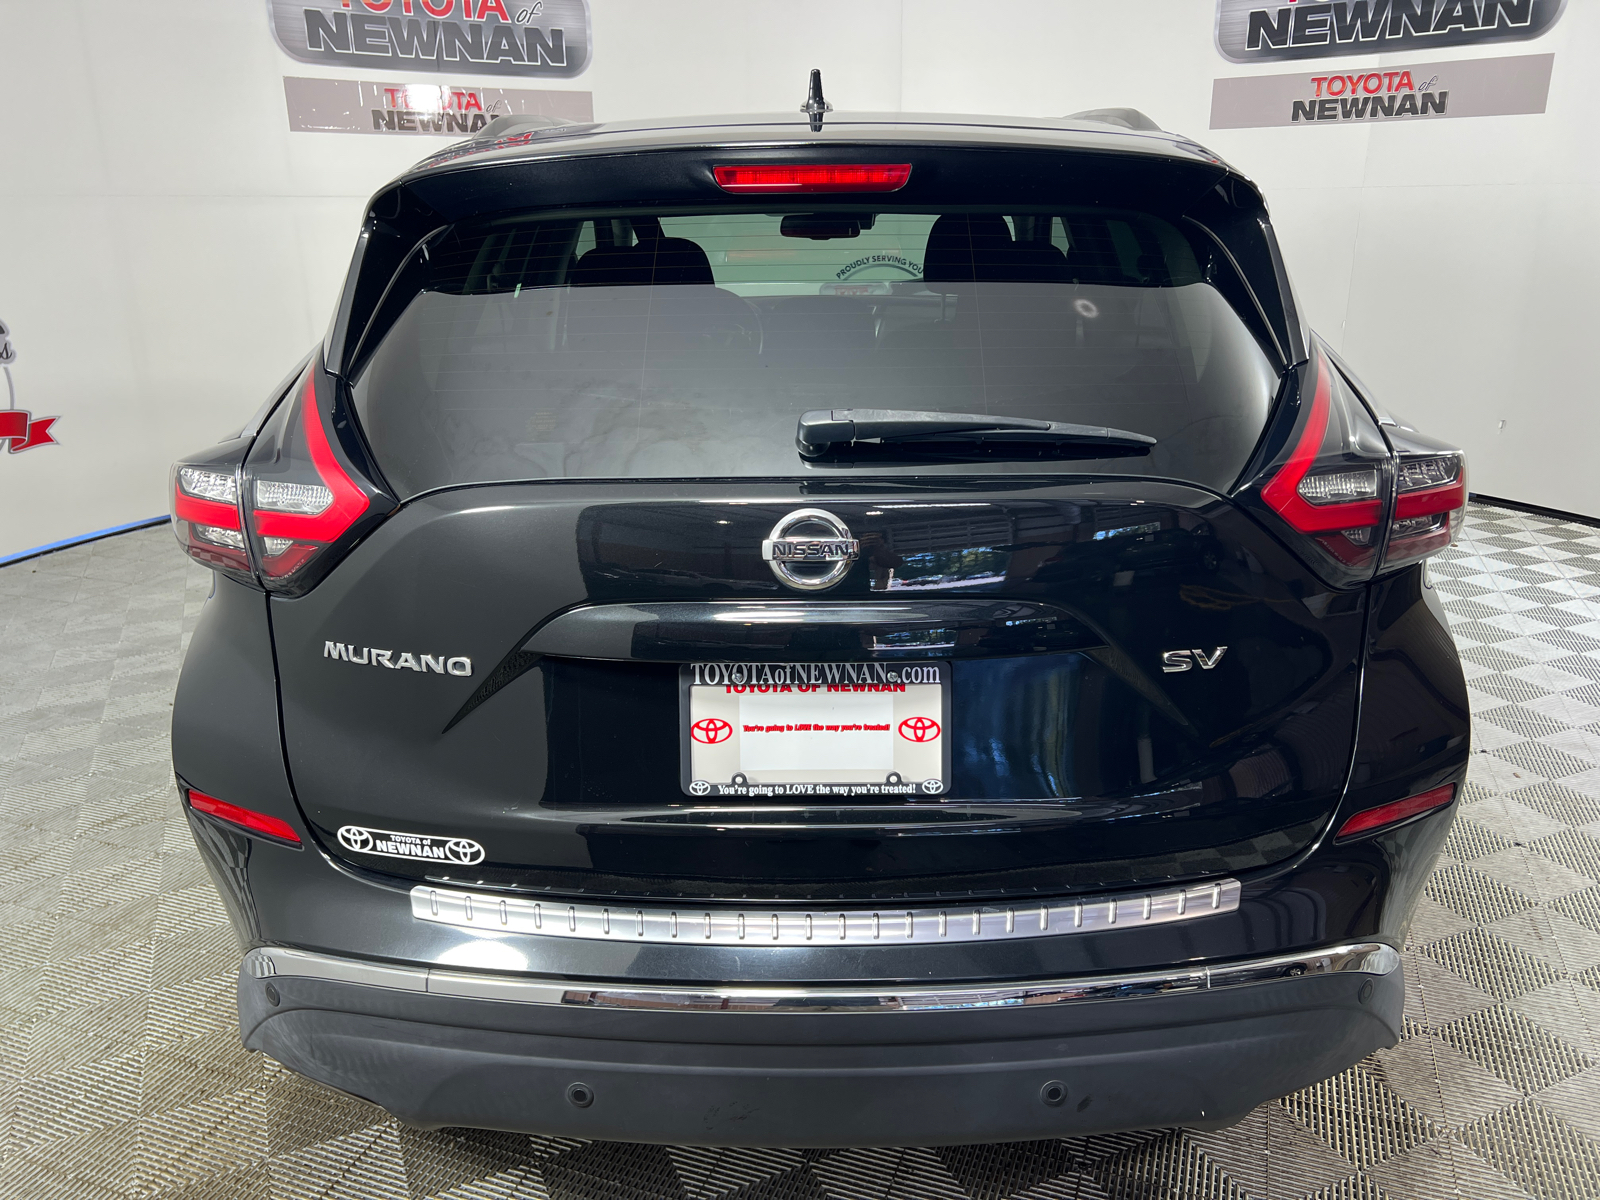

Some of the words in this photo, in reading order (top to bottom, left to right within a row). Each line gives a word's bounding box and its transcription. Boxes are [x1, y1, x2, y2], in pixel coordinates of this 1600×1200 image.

[516, 1, 542, 24] of
[1246, 0, 1531, 49] NEWNAN
[304, 9, 567, 66] NEWNAN
[1311, 71, 1414, 97] TOYOTA
[1418, 75, 1438, 92] of
[485, 99, 501, 113] of
[1291, 91, 1448, 122] NEWNAN
[371, 109, 500, 133] NEWNA
[836, 256, 870, 279] PROUDLY
[872, 255, 907, 266] SERVING
[908, 261, 924, 275] YOU
[773, 544, 849, 556] NISSAN
[323, 640, 473, 677] MURANO
[1163, 646, 1228, 673] SV
[718, 784, 747, 795] You're
[748, 785, 773, 797] going
[775, 785, 784, 795] to
[786, 784, 814, 794] LOVE
[816, 784, 831, 794] the
[832, 785, 849, 796] way
[851, 784, 879, 796] you're
[881, 783, 916, 794] treated!
[375, 839, 446, 859] NEWNAN
[390, 835, 421, 845] TOYOTA
[422, 838, 431, 846] of
